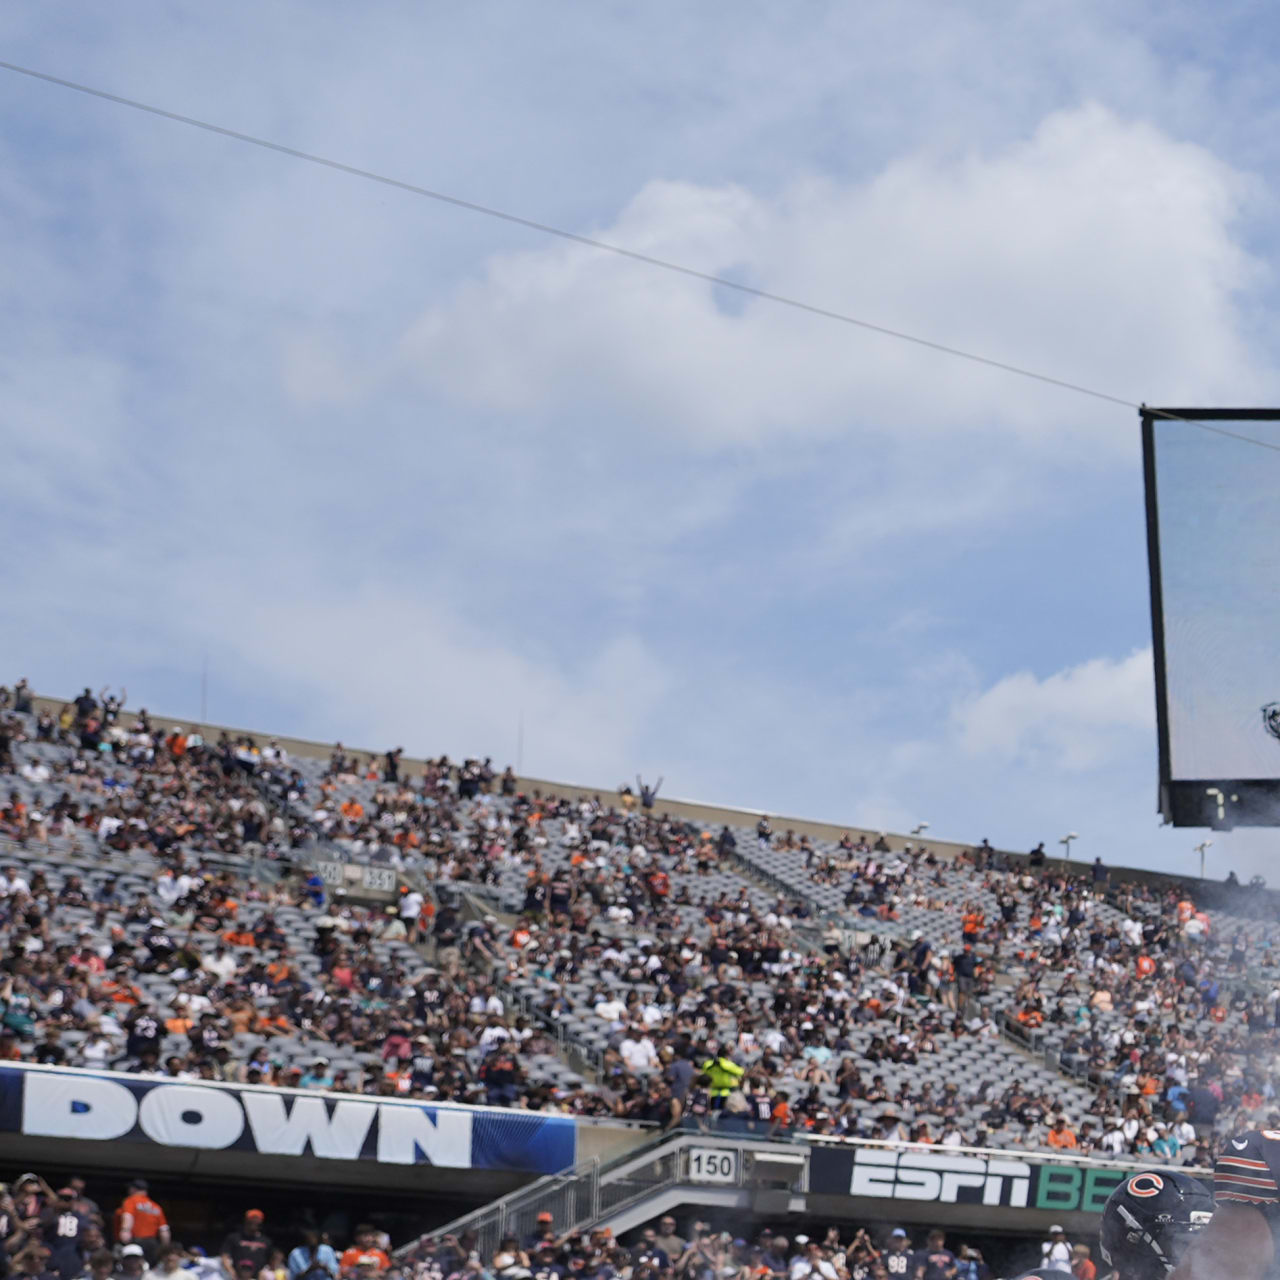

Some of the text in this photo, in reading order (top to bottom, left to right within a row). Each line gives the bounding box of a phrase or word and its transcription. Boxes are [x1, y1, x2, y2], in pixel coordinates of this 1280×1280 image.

[22, 1071, 472, 1168] DOWN
[693, 1154, 732, 1178] 150
[850, 1149, 1148, 1213] ESPN BE
